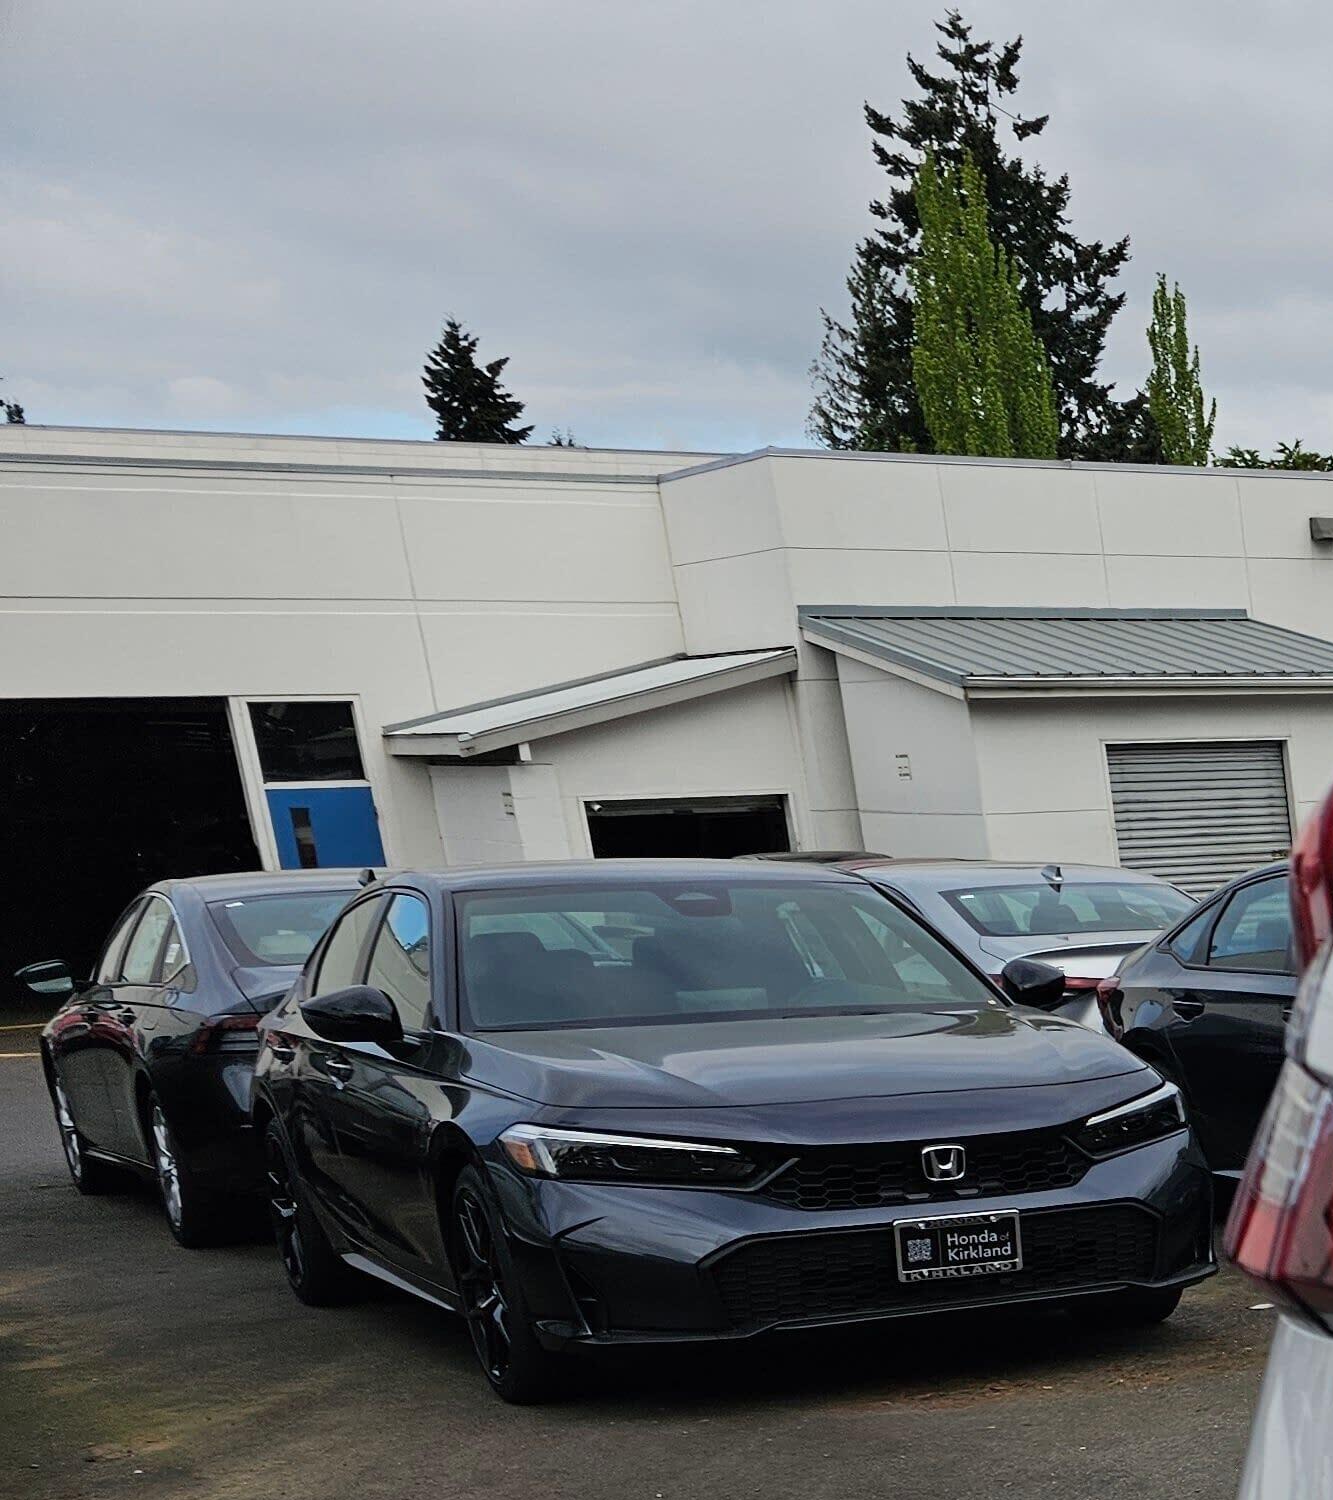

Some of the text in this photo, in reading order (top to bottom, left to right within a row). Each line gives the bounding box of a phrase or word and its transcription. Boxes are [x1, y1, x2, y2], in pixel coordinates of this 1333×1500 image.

[946, 1229, 1010, 1247] Honda of
[947, 1241, 1012, 1262] Kirkland
